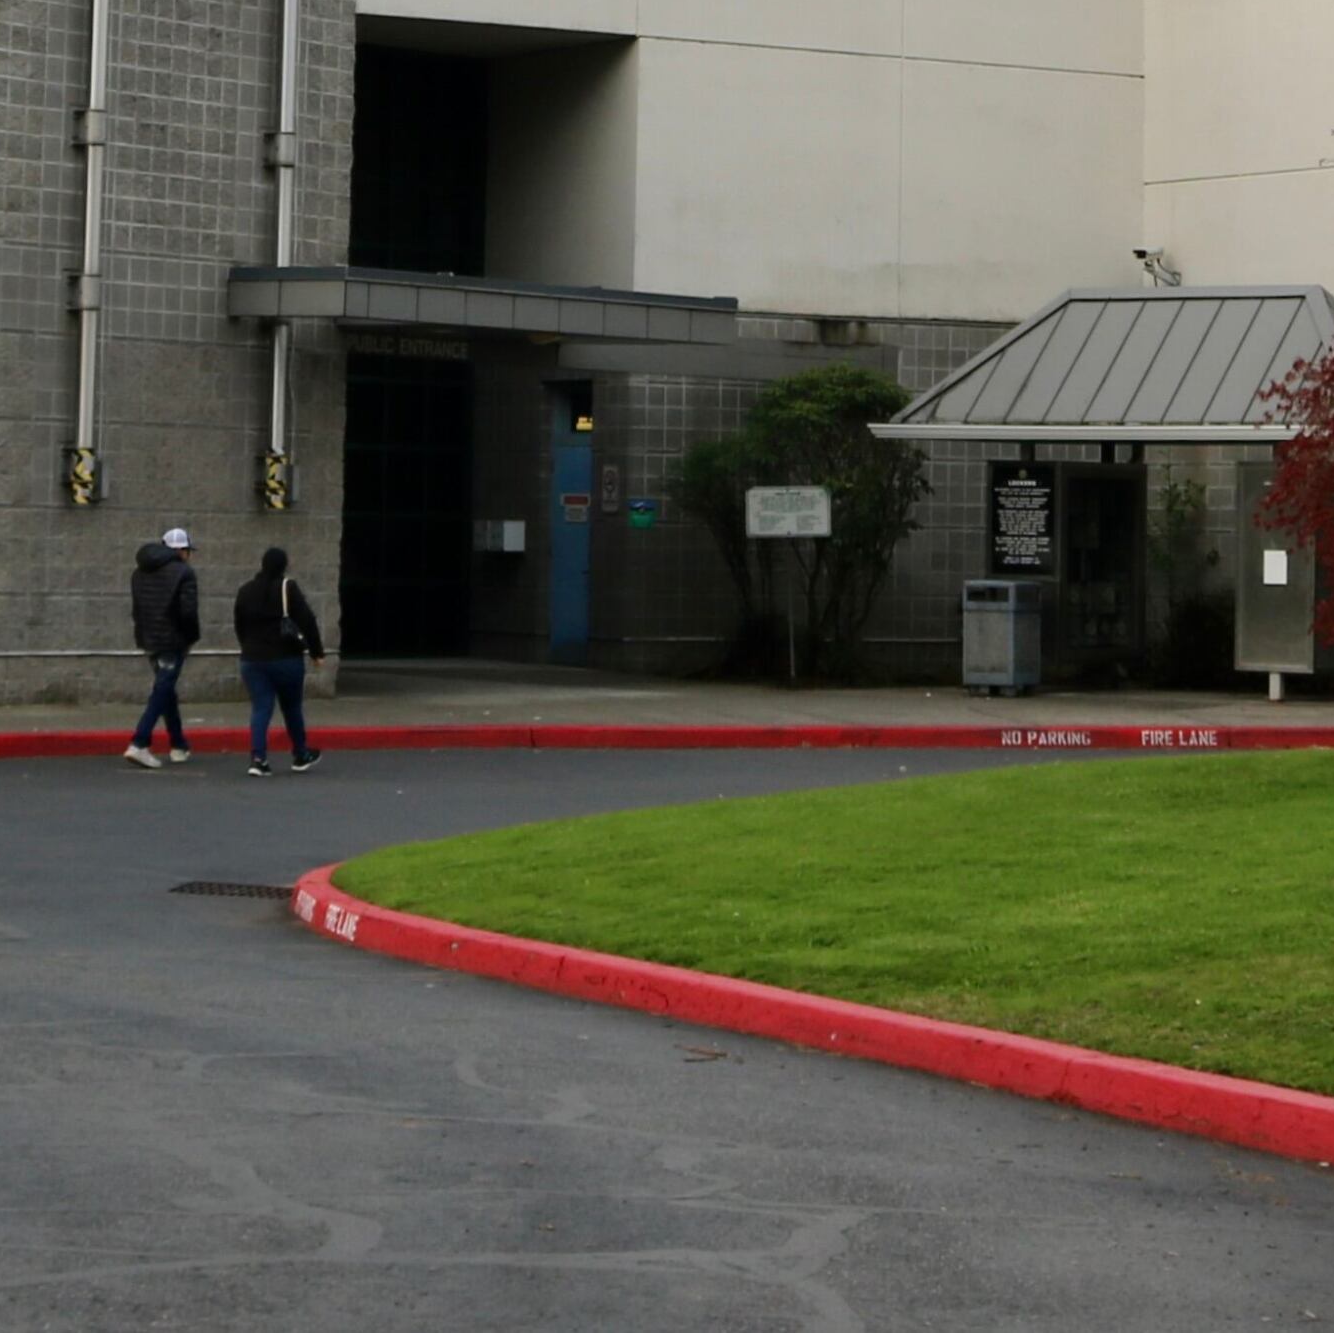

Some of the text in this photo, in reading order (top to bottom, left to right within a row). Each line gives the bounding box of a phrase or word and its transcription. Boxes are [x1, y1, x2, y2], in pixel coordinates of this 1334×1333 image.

[347, 333, 469, 360] PUBLIC ENTRANCE
[1001, 730, 1217, 746] NO PARKING FIRE LANE
